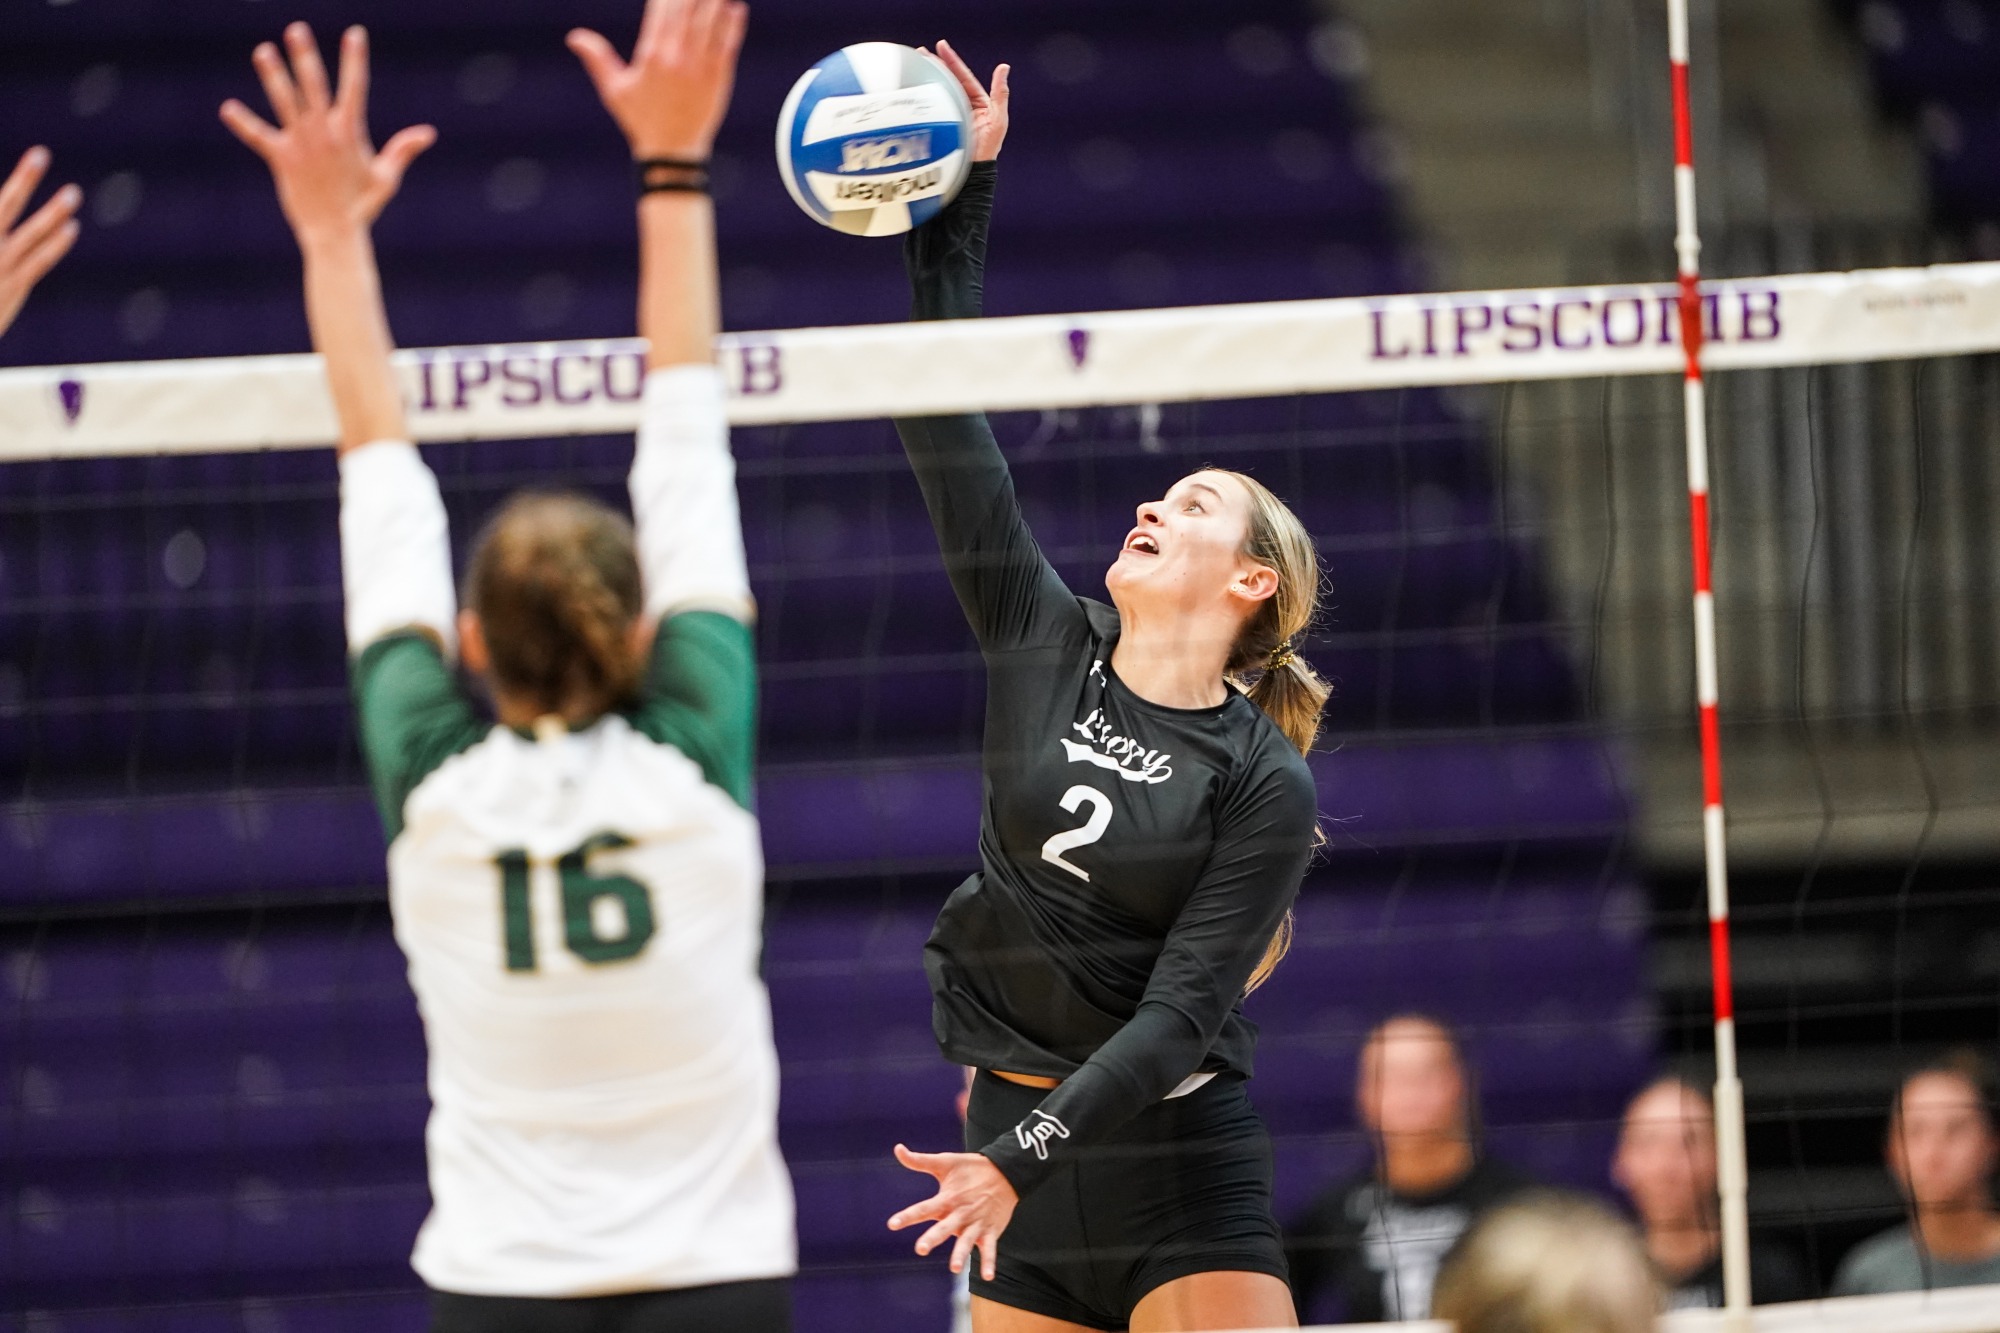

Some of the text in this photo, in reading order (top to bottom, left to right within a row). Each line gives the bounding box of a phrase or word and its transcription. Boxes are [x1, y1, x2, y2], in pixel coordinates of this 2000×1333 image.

[404, 344, 783, 411] IPSCOB
[1041, 784, 1114, 883] 2
[496, 829, 658, 971] 16
